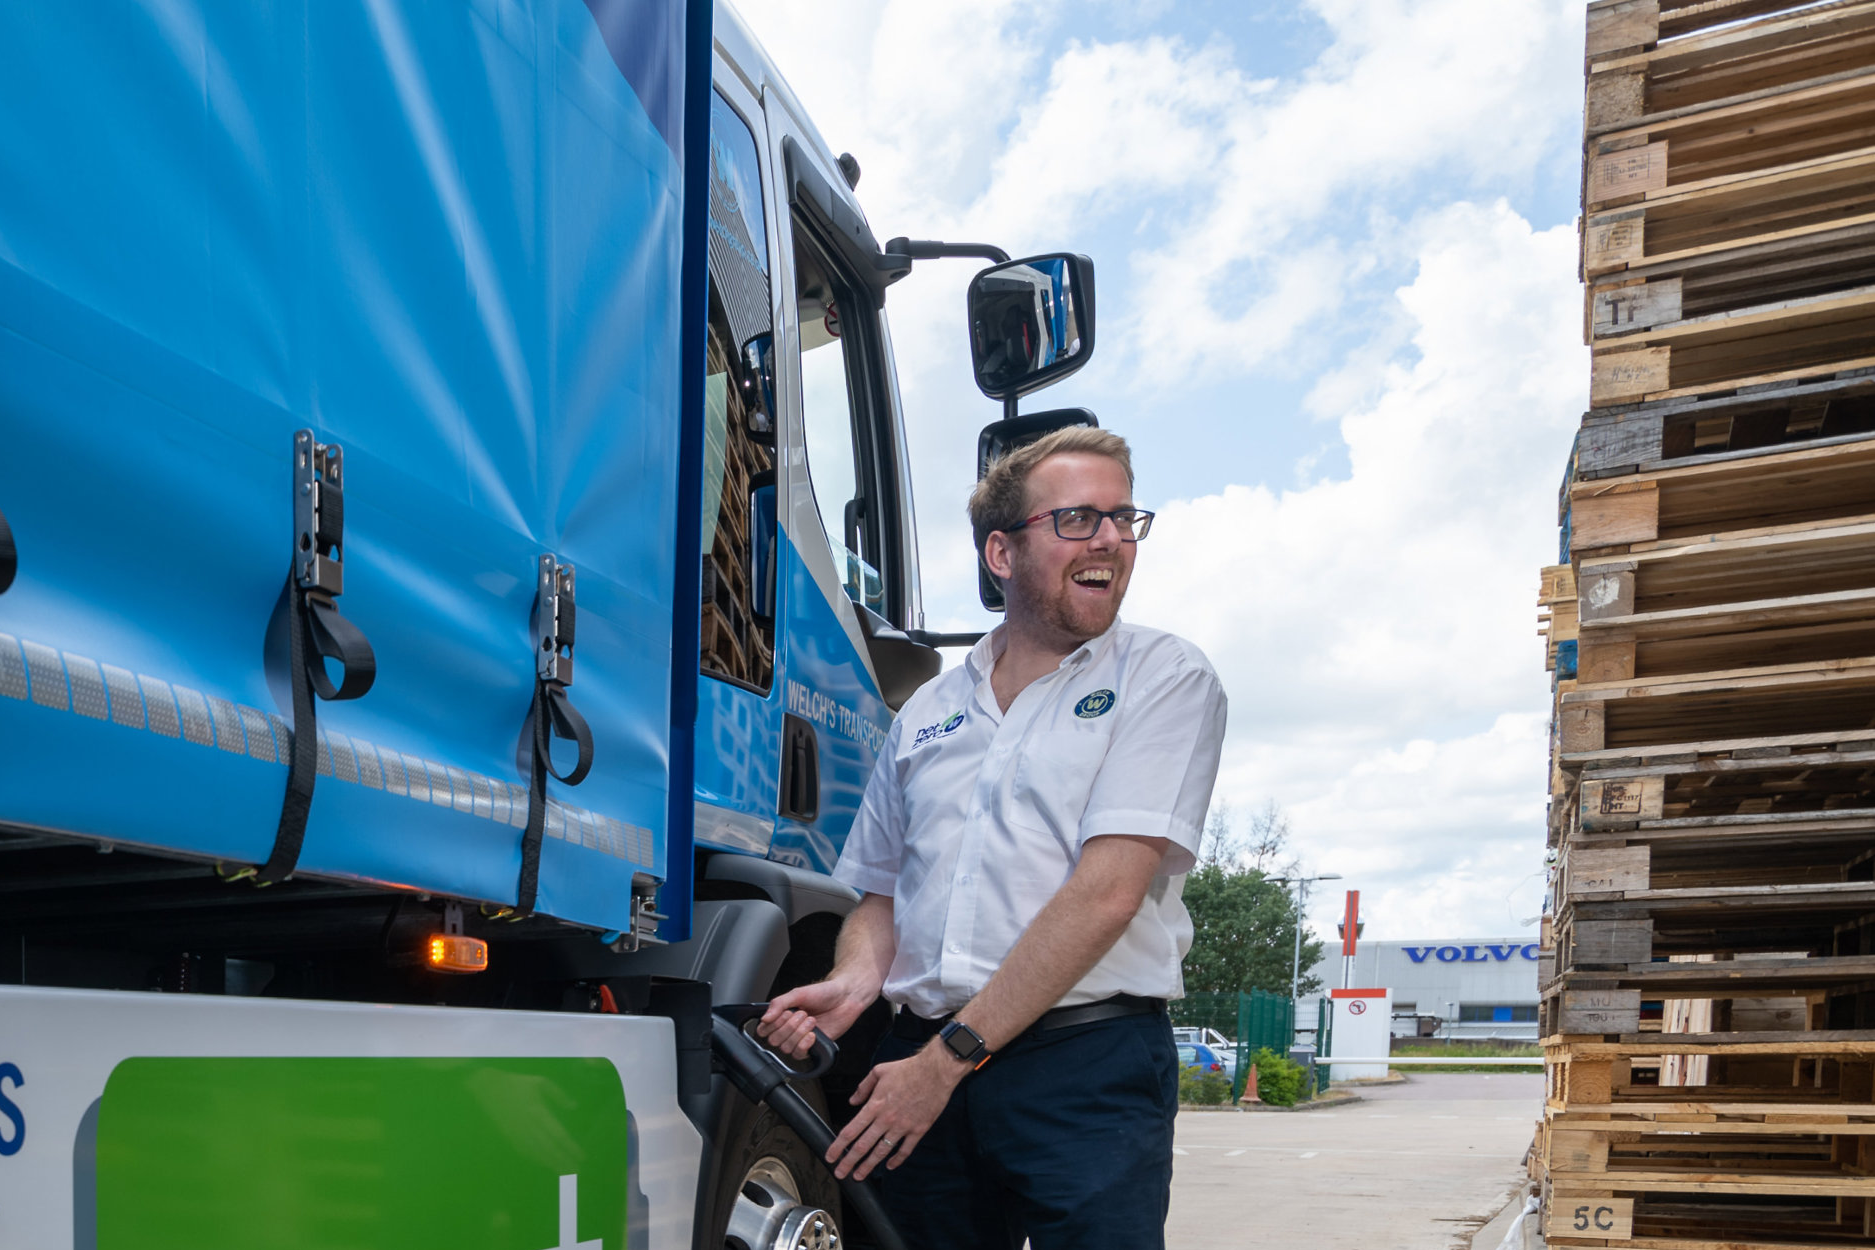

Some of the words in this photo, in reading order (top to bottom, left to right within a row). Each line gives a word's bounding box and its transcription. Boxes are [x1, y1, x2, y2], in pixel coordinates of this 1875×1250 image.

[788, 679, 836, 729] WELCH'S
[912, 729, 943, 748] zero
[916, 723, 941, 739] net
[1573, 1205, 1614, 1231] 5C
